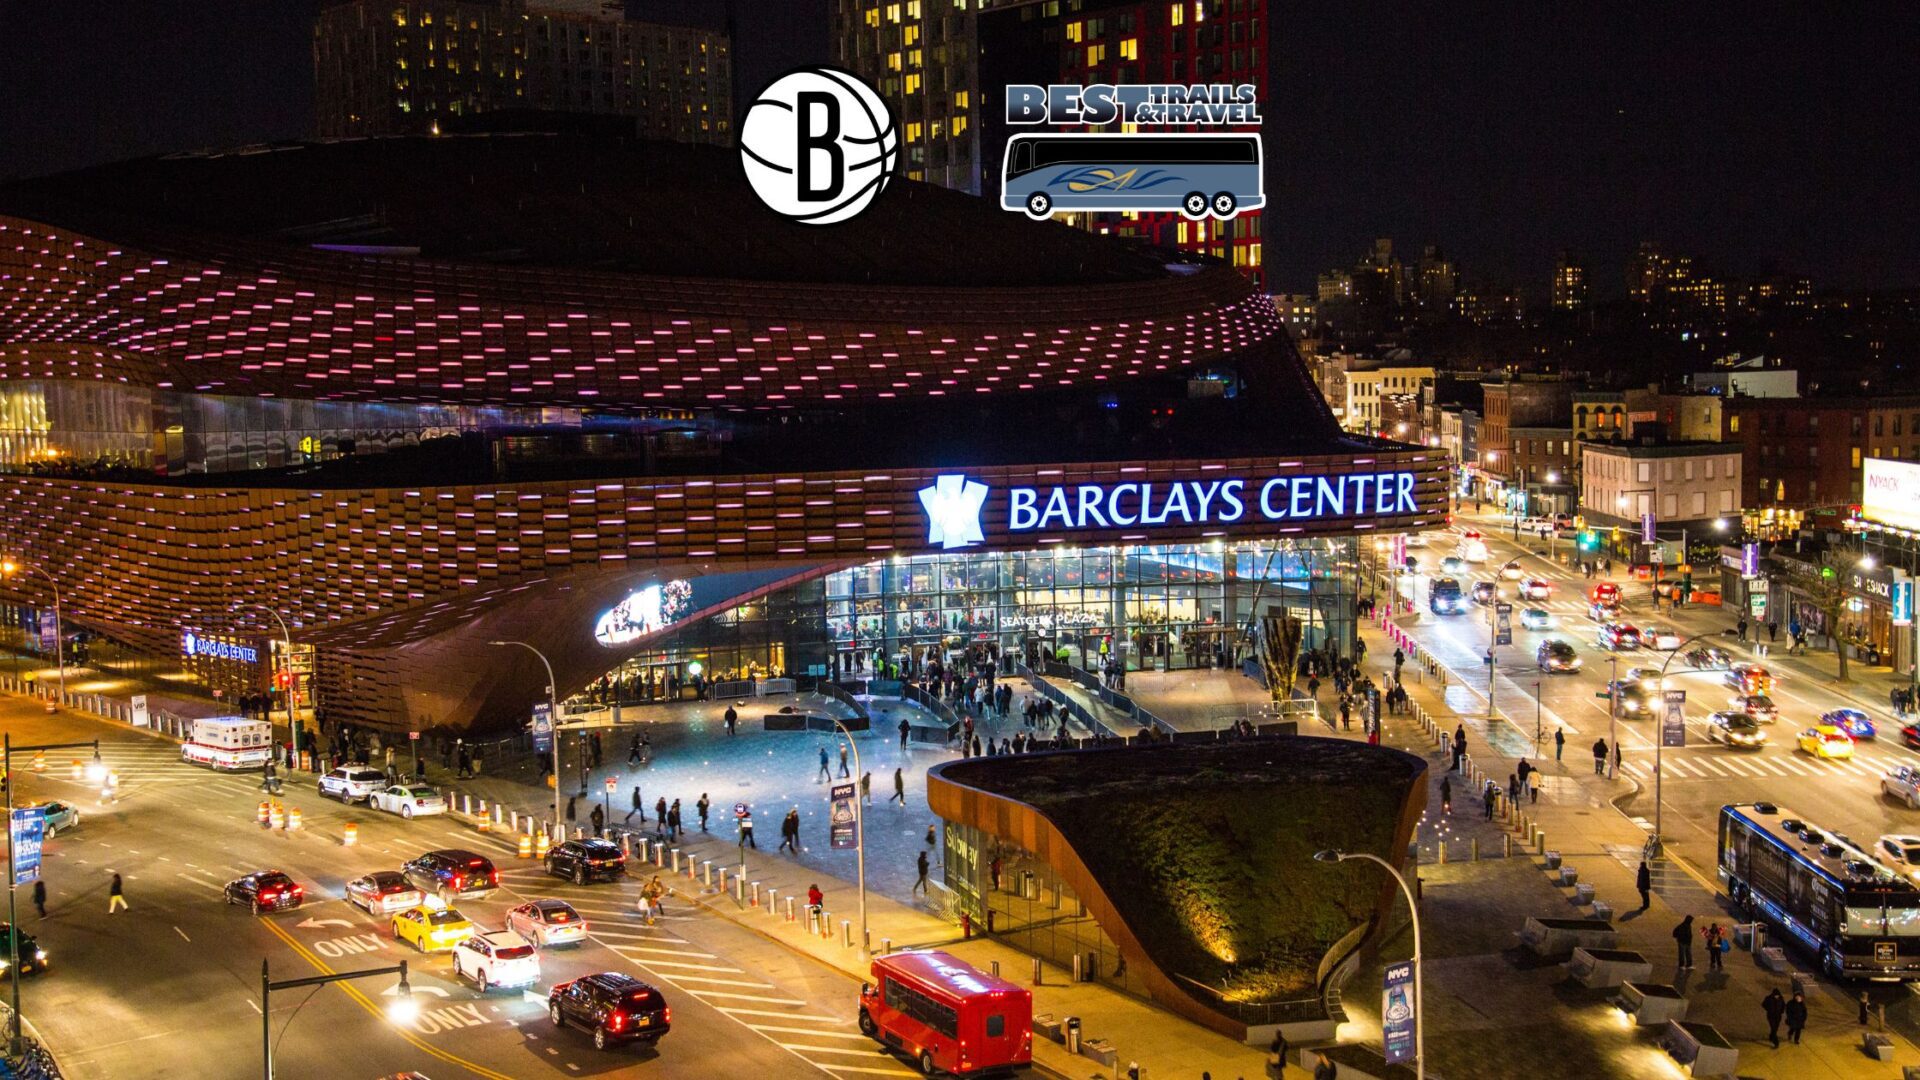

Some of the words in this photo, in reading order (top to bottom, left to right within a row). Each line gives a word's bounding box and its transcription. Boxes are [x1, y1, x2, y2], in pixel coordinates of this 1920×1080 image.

[1009, 480, 1244, 530] BARCLAYS
[1260, 473, 1418, 519] CENTER
[1056, 612, 1097, 624] PLAZA
[197, 640, 229, 658] BARCLAYS
[230, 646, 257, 663] CENTER
[134, 702, 145, 710] VIP
[834, 786, 852, 796] NYC
[313, 932, 390, 958] ONLY
[1388, 966, 1410, 980] NYC
